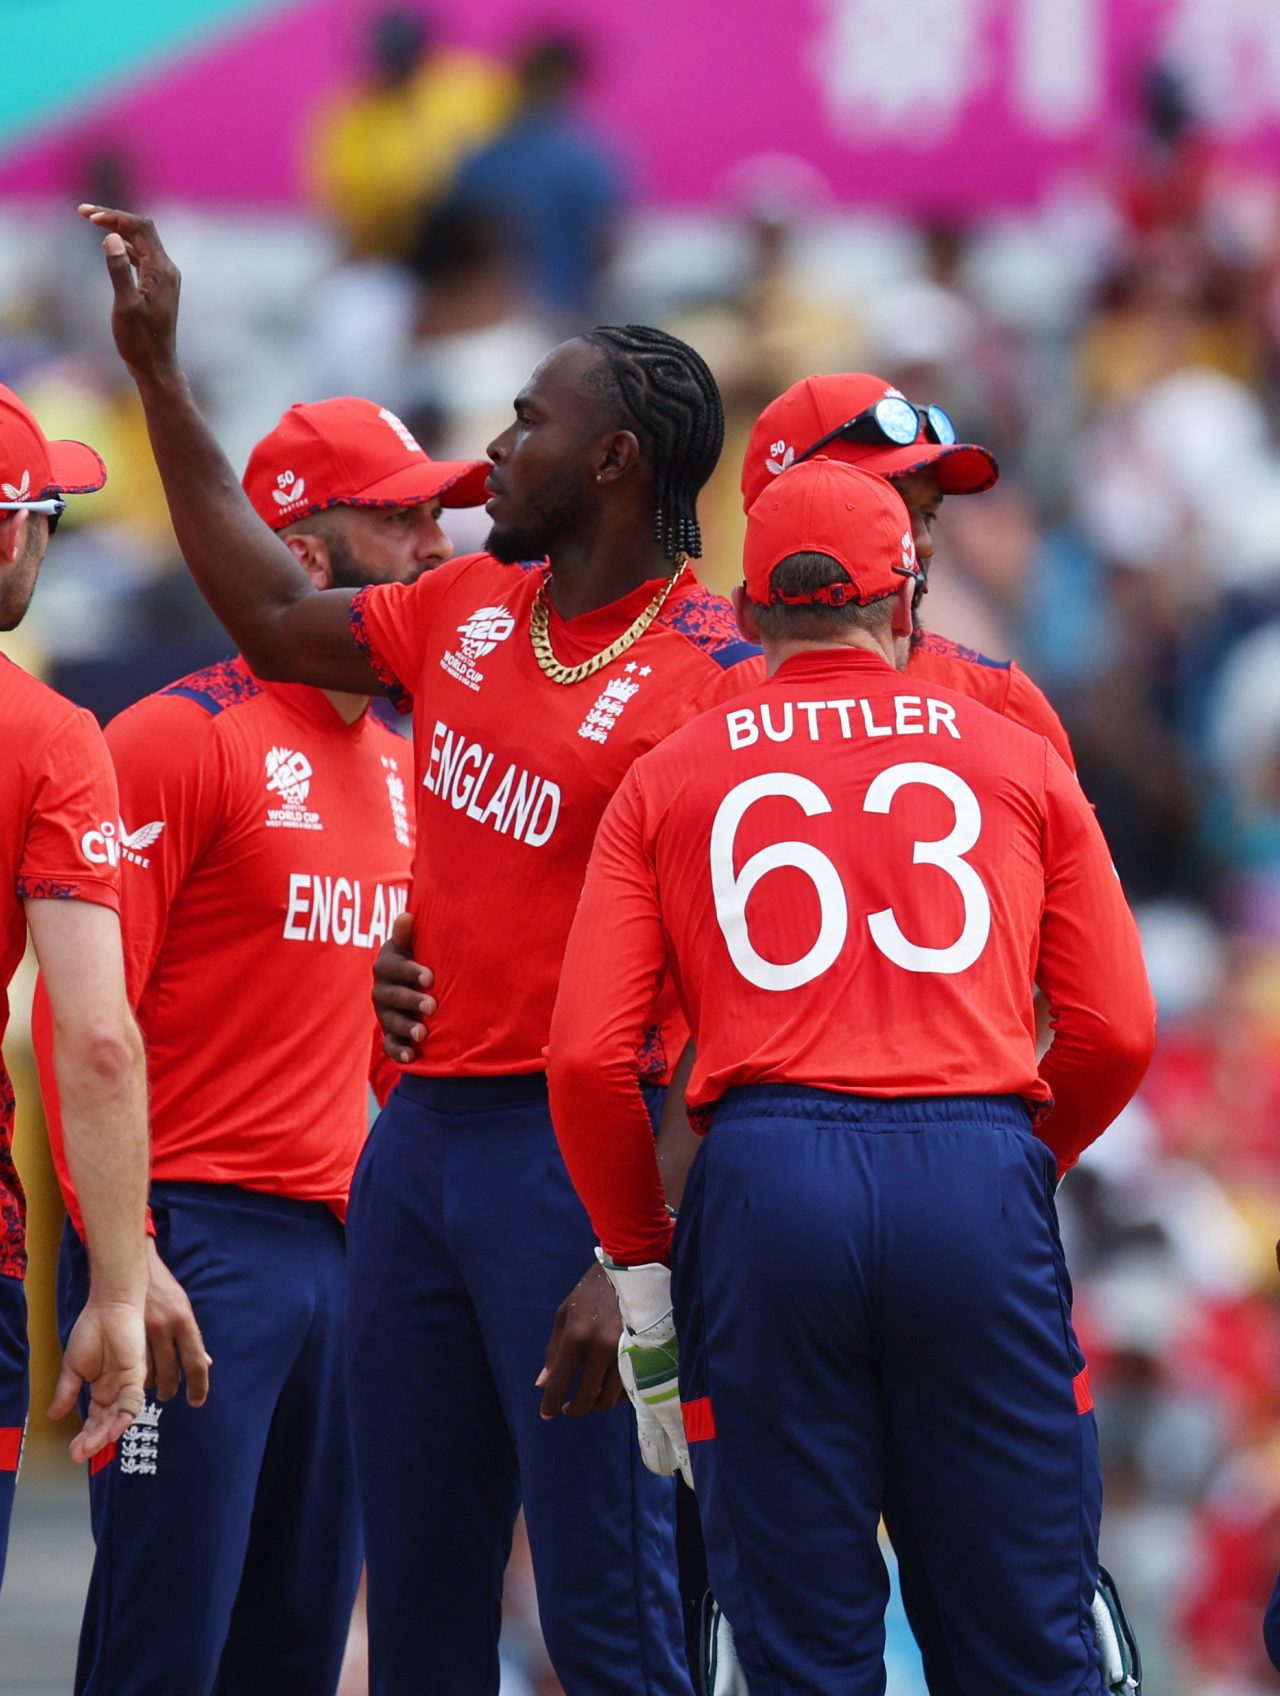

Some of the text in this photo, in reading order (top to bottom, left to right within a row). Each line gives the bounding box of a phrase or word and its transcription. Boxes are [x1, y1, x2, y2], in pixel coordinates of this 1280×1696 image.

[770, 440, 785, 457] 50
[277, 470, 294, 489] 50
[443, 649, 484, 683] WORLD CUP
[725, 695, 962, 751] BUTTLER
[422, 719, 562, 848] ENGLAND
[267, 809, 302, 822] WORLD
[121, 847, 150, 869] TORE
[709, 761, 992, 992] 63
